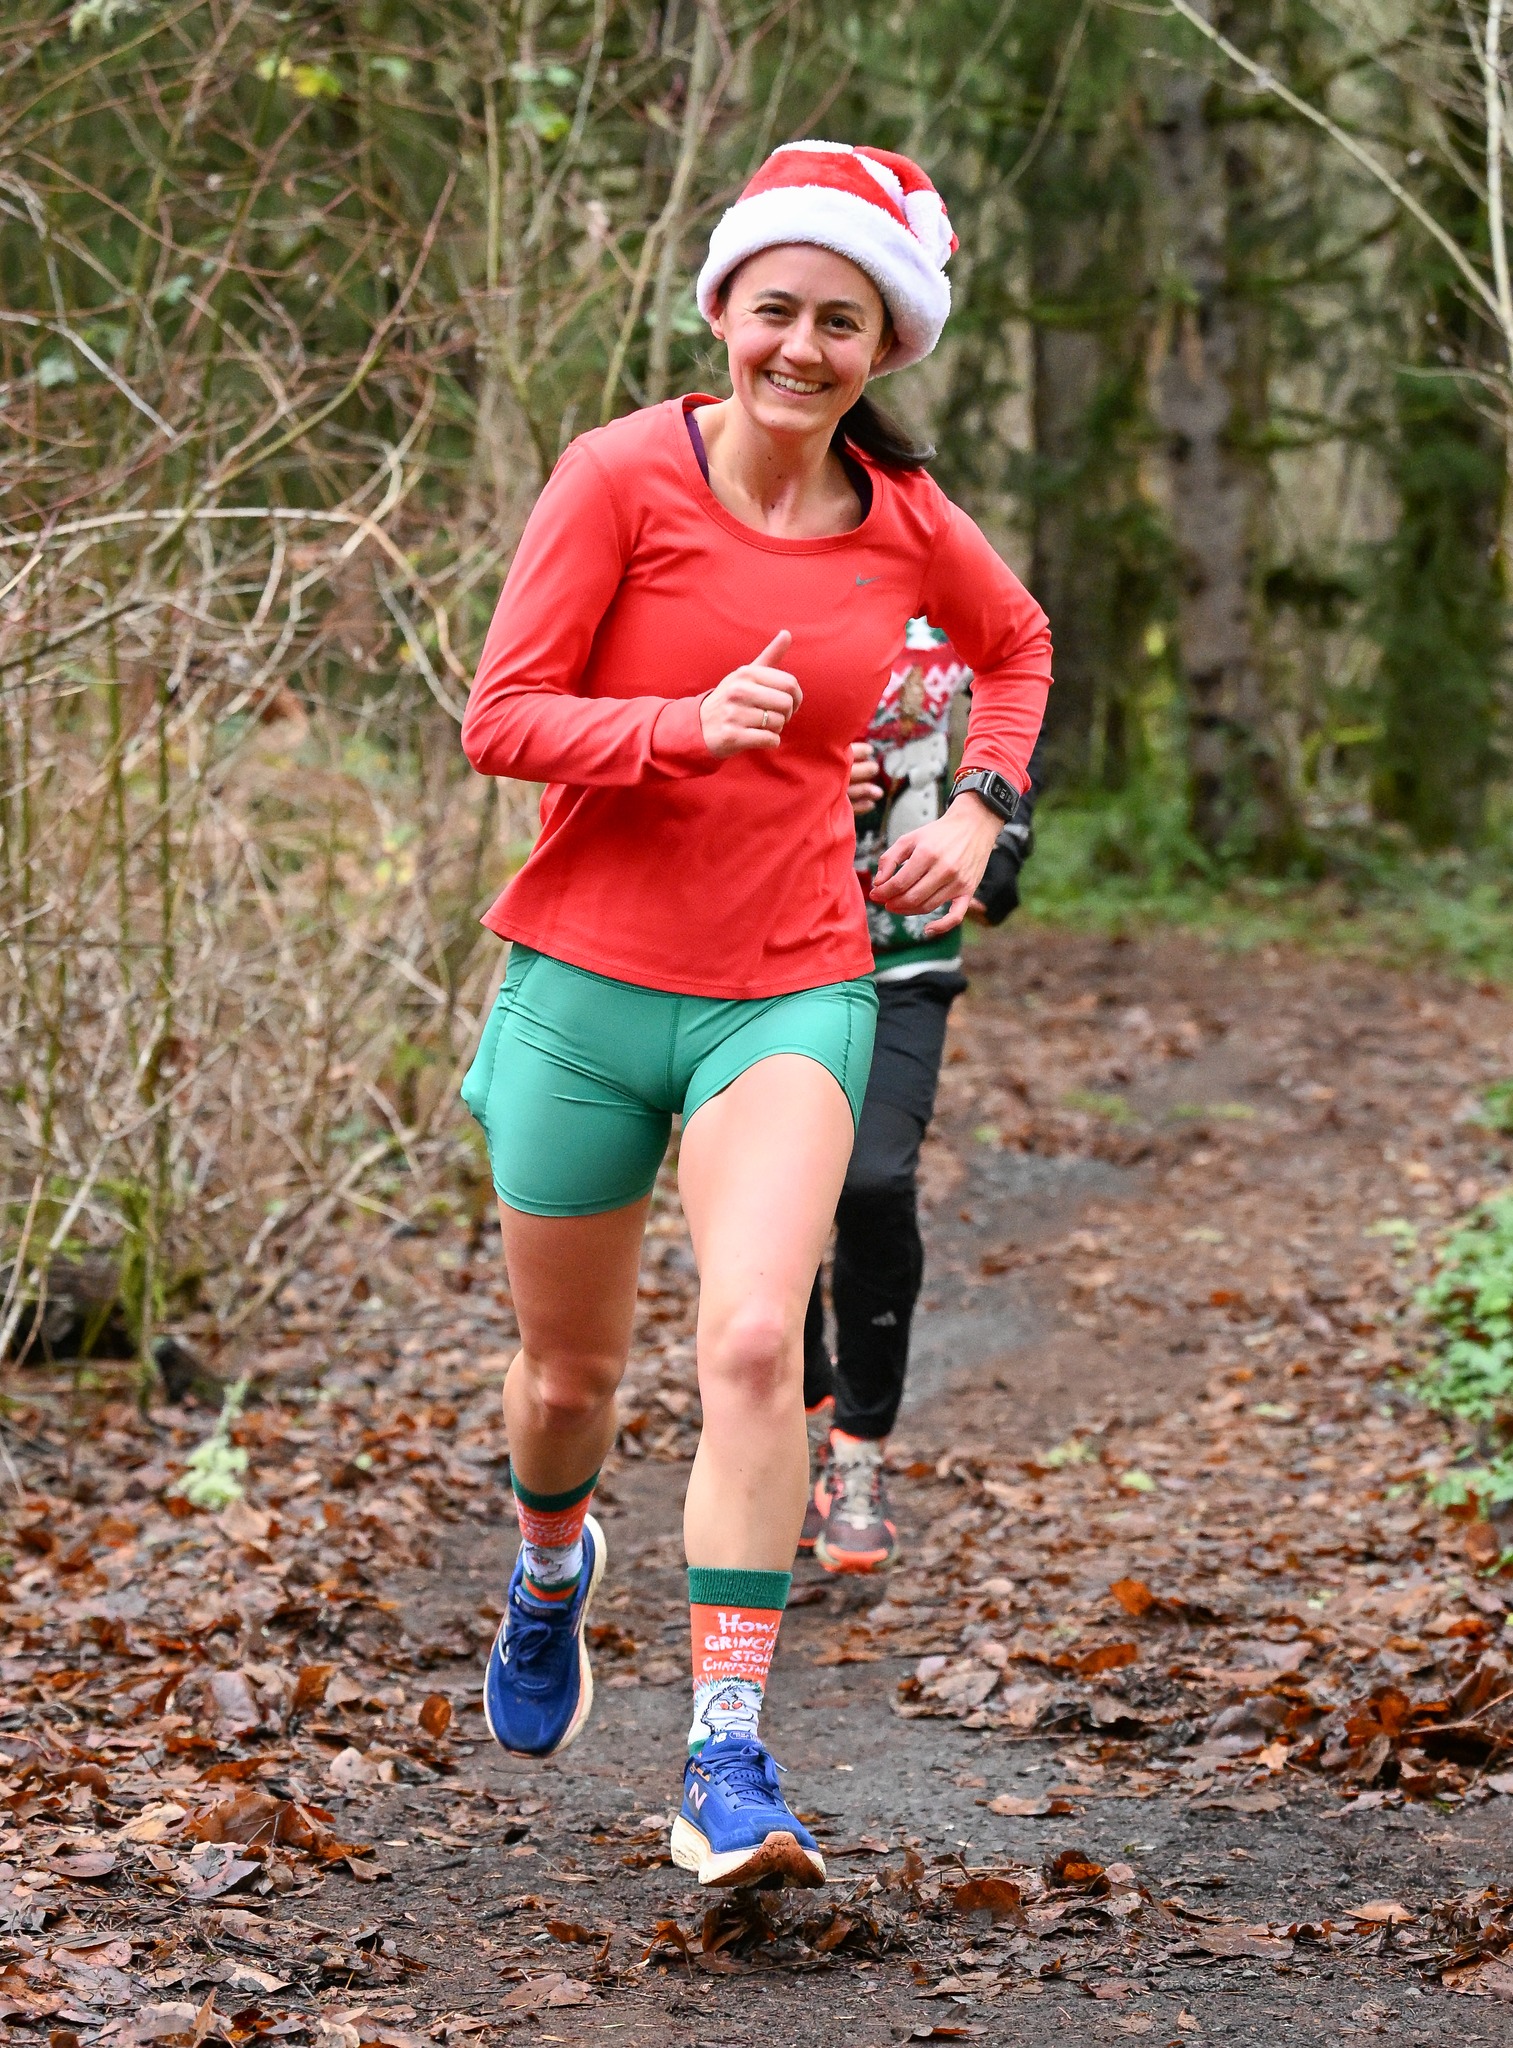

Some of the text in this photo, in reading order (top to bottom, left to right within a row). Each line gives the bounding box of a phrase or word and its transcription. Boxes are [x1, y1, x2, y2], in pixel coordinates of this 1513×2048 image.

[704, 1635, 777, 1652] GRINCH
[729, 1650, 774, 1664] STOL
[688, 1781, 708, 1811] N
